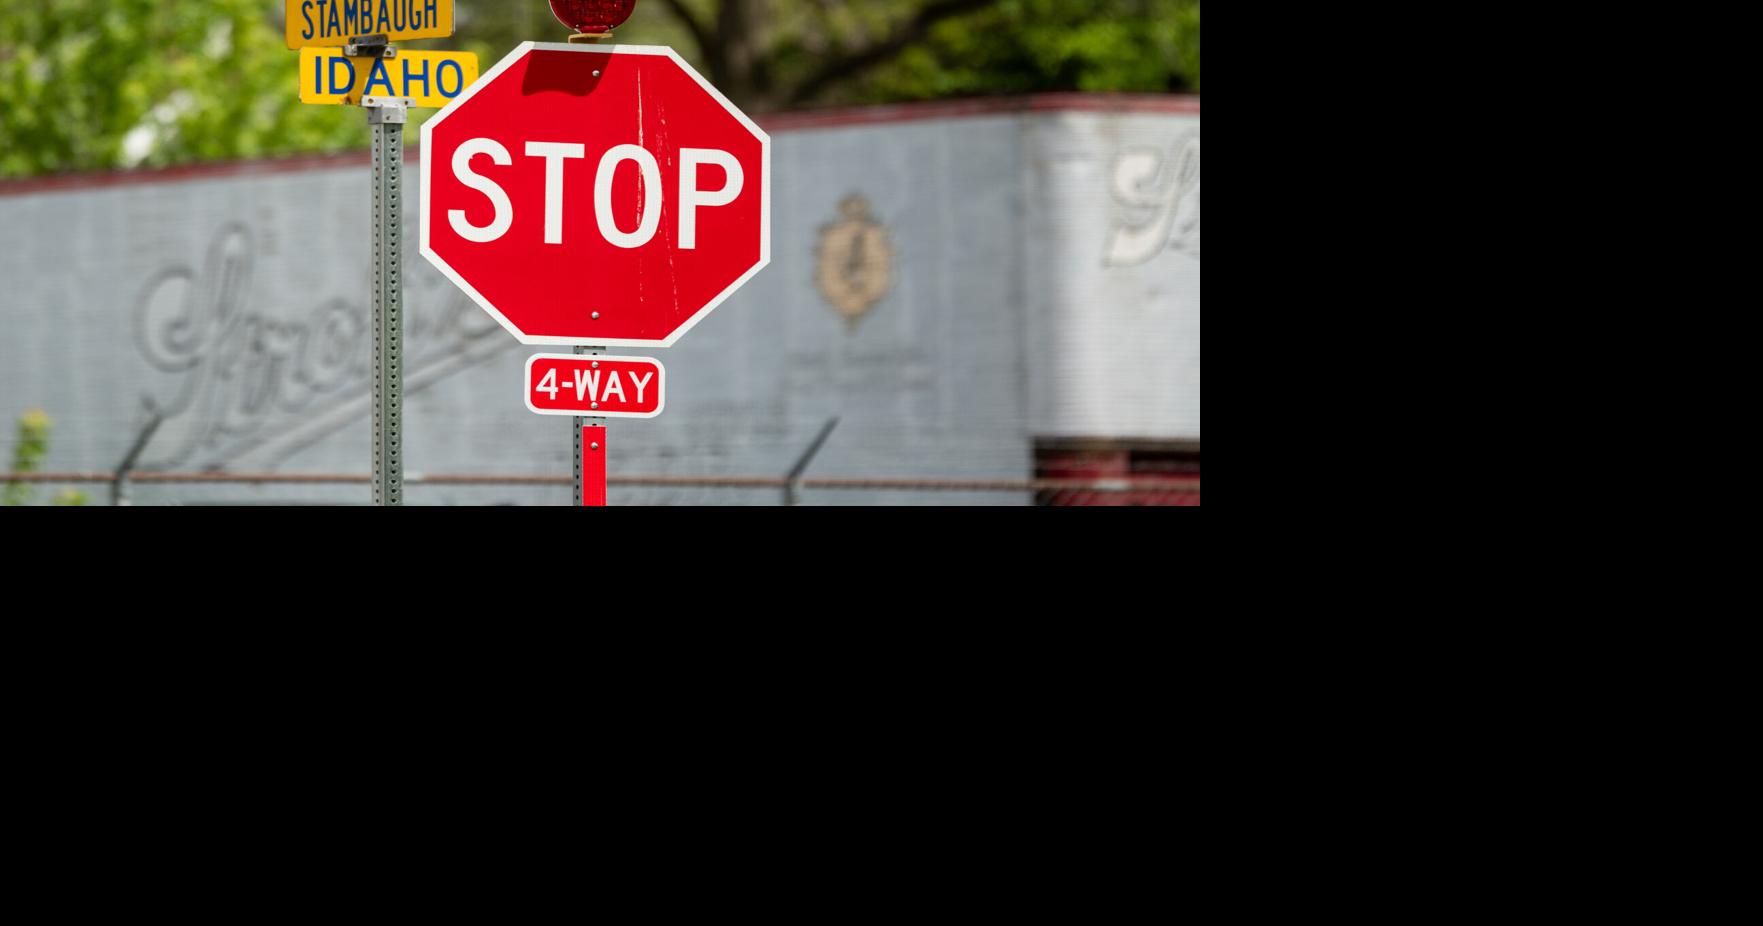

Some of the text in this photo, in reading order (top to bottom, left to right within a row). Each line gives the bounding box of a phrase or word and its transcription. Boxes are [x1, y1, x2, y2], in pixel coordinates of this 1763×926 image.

[302, 0, 437, 40] STAMBAUGH
[315, 55, 464, 99] IDAHO
[447, 137, 745, 250] STOP
[535, 367, 654, 404] 4-WAY
